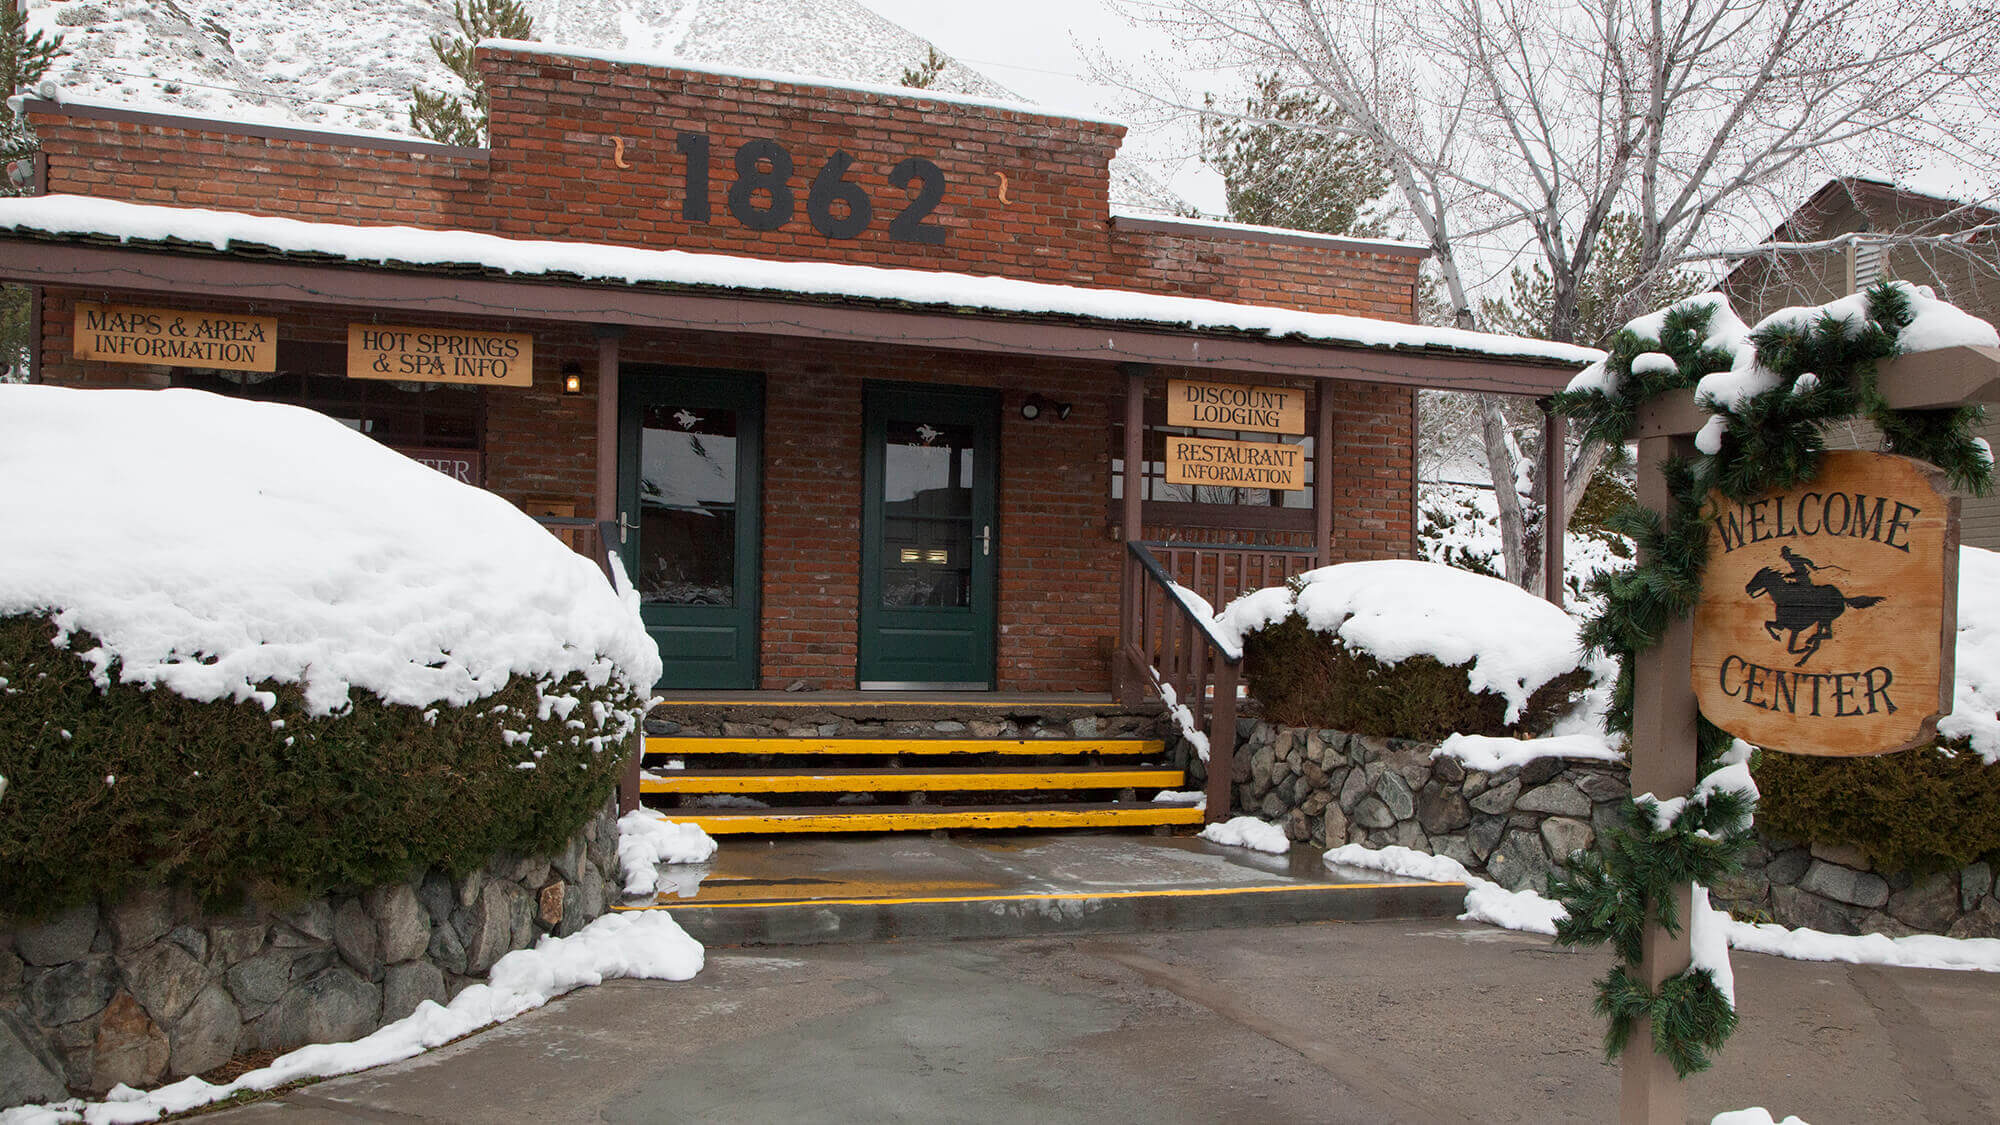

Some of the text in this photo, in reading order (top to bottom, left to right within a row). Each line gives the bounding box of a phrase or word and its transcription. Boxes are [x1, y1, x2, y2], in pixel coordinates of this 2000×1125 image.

[676, 132, 946, 245] 1862
[86, 310, 266, 343] MAPS & AREA
[95, 334, 256, 363] INFORMATION
[363, 330, 519, 359] HOT SPRINGS
[373, 353, 508, 379] & SPA INFO
[1186, 385, 1288, 410] DISCOUNT
[1193, 404, 1280, 428] LODGING
[1177, 442, 1297, 467] RESTAURANT
[1182, 463, 1292, 484] INFORMATION
[1714, 491, 1921, 553] WELCOME
[1719, 654, 1899, 717] CENTER
